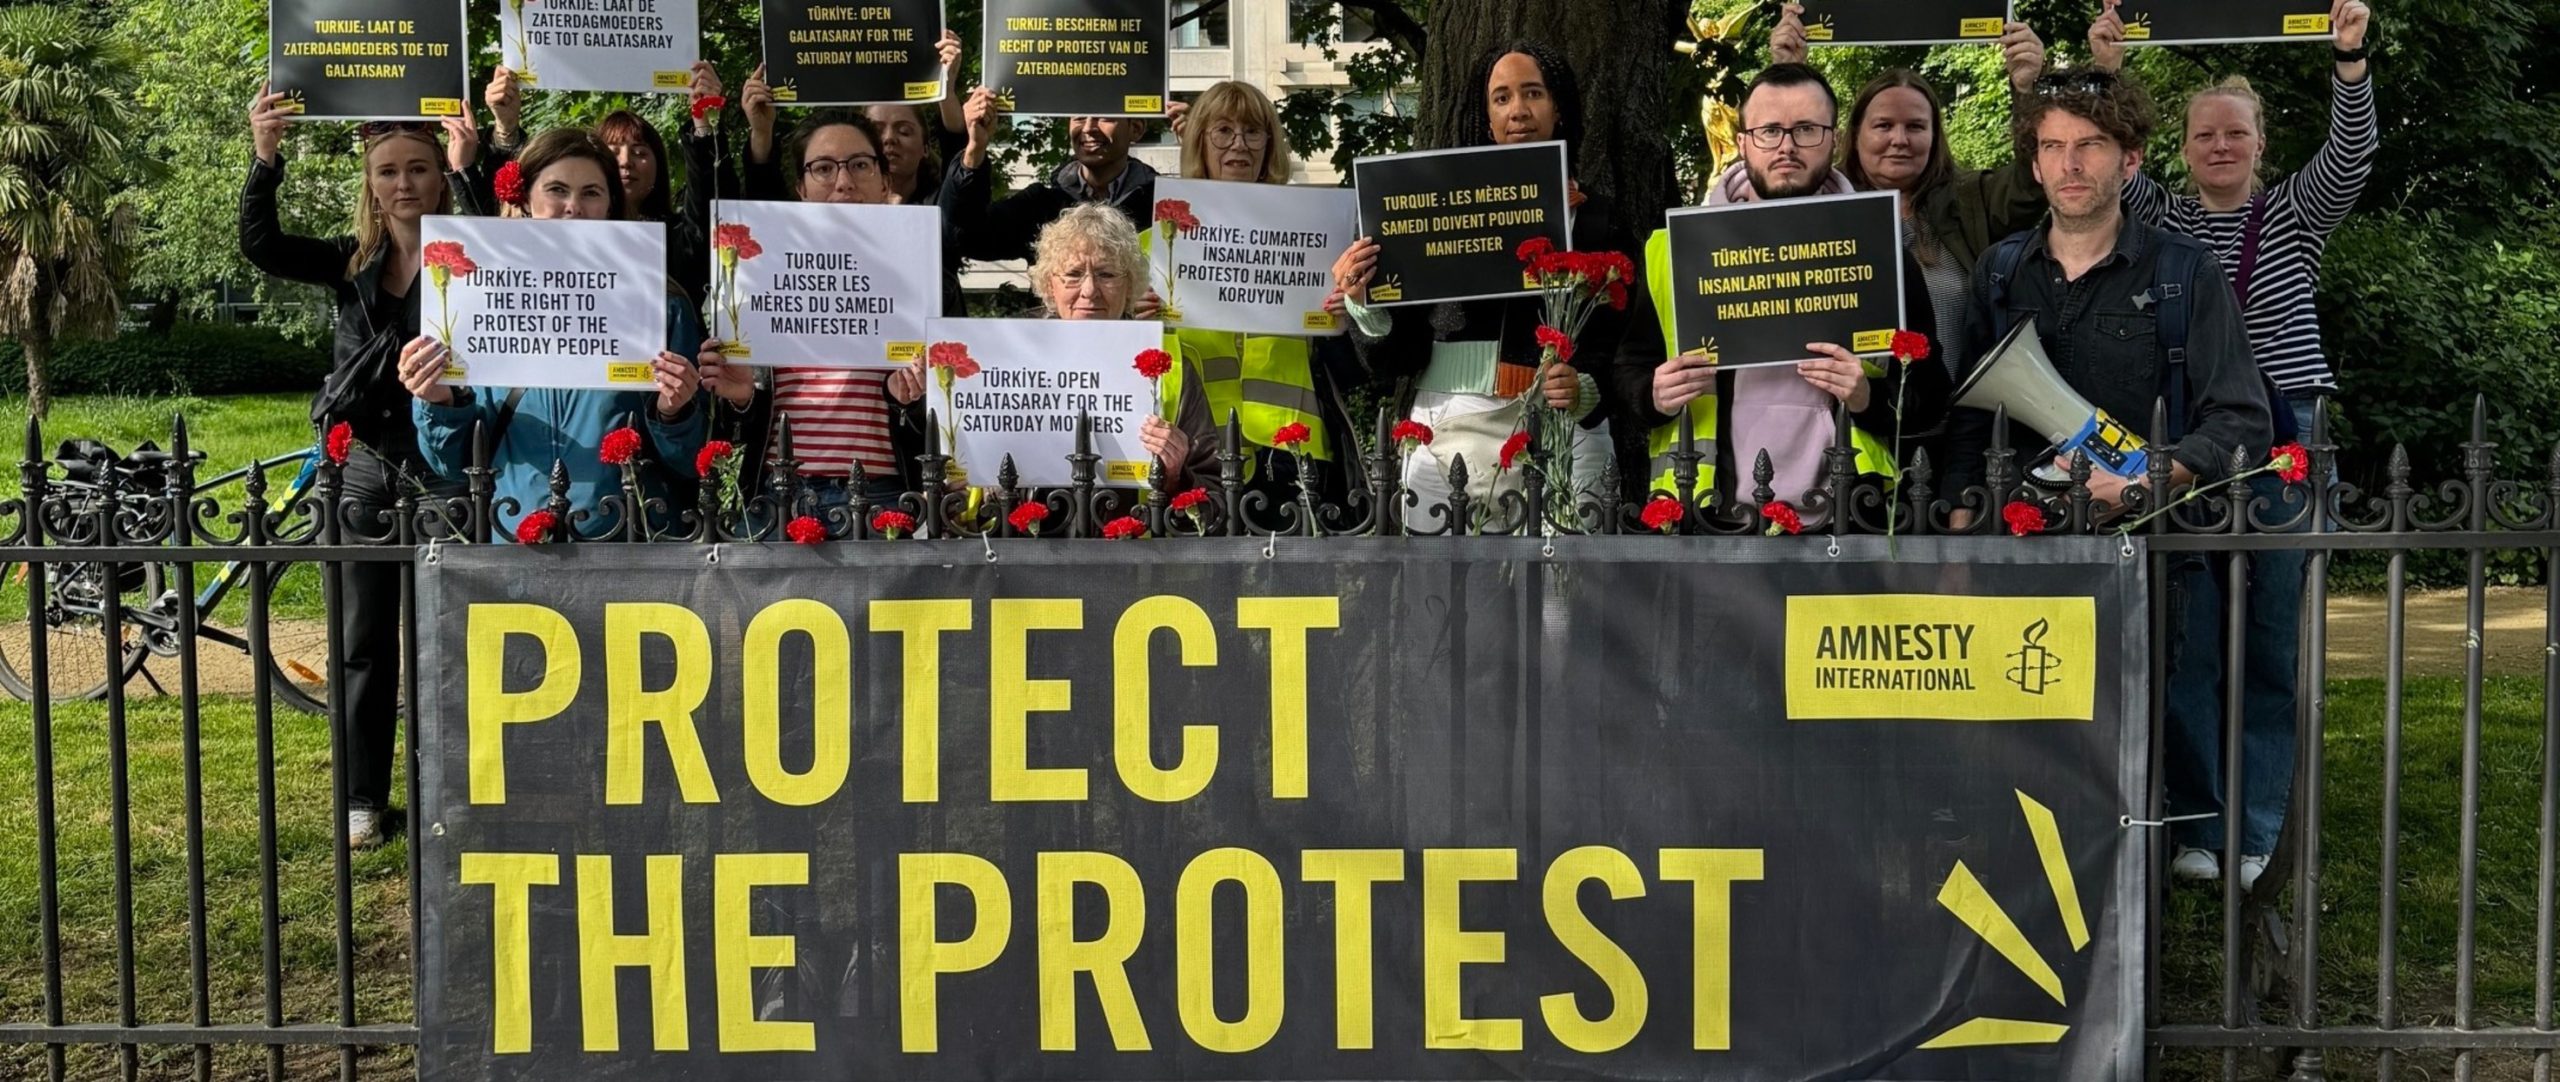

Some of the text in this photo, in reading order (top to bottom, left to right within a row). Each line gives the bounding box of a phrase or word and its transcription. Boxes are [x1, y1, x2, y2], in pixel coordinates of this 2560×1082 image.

[603, 0, 633, 12] LAAT
[639, 0, 655, 12] DE
[808, 5, 891, 20] TÜRKİYE: OPEN
[314, 20, 415, 34] TURKIJE: LAAT DE
[532, 13, 663, 30] ZATERDAGMOEDERS
[1006, 18, 1142, 32] TURKIJE: BESCHERM HET
[527, 31, 673, 48] TOE TOT GALATASARAY
[789, 29, 913, 42] GALATASARAY FOR THE
[283, 42, 448, 56] ZATERDAGMOEDERS TOE TOT
[1000, 40, 1148, 54] RECHT OP PROTEST VAN DE
[796, 51, 908, 64] SATURDAY MOTHERS
[326, 64, 406, 78] GALATASARAY
[1016, 62, 1127, 75] ZATERDAGMOEDERS
[1383, 193, 1438, 211] TURQUIE
[1450, 190, 1471, 206] LES
[1475, 184, 1517, 203] MÈRES
[1521, 184, 1538, 200] DU
[1381, 209, 1544, 236] SAMEDI DOIVENT POUVOIR
[1251, 230, 1327, 248] CUMARTESI
[1426, 236, 1503, 256] MANIFESTER
[785, 253, 857, 271] TURQUIE:
[1203, 244, 1305, 267] İNSANLARI'NIN
[1711, 239, 1856, 267] TÜRKİYE: CUMARTESI
[466, 266, 617, 290] TÜRKİYE: PROTECT
[774, 274, 869, 292] LAISSER LES
[1178, 264, 1325, 287] PROTESTO HAKLARINI
[1699, 265, 1872, 295] İNSANLARI'NIN PROTESTO
[485, 292, 595, 311] THE RIGHT TO
[751, 291, 894, 314] MÈRES DU SAMEDI
[1218, 287, 1284, 304] KORUYUN
[1717, 293, 1858, 320] HAKLARINI KORUYUN
[474, 315, 608, 333] PROTEST OF THE
[771, 317, 867, 335] MANIFESTER
[468, 336, 619, 356] SATURDAY PEOPLE
[982, 367, 1100, 389] TÜRKİYE: OPEN
[955, 392, 1133, 412] GALATASARAY FOR THE
[964, 415, 1123, 433] SATURDAY MOERS
[1816, 624, 1975, 661] AMNESTY
[1816, 667, 1975, 690] INTERNATIONAL
[467, 595, 1339, 805] PROTECT
[462, 846, 1764, 1054] THE PROTEST
